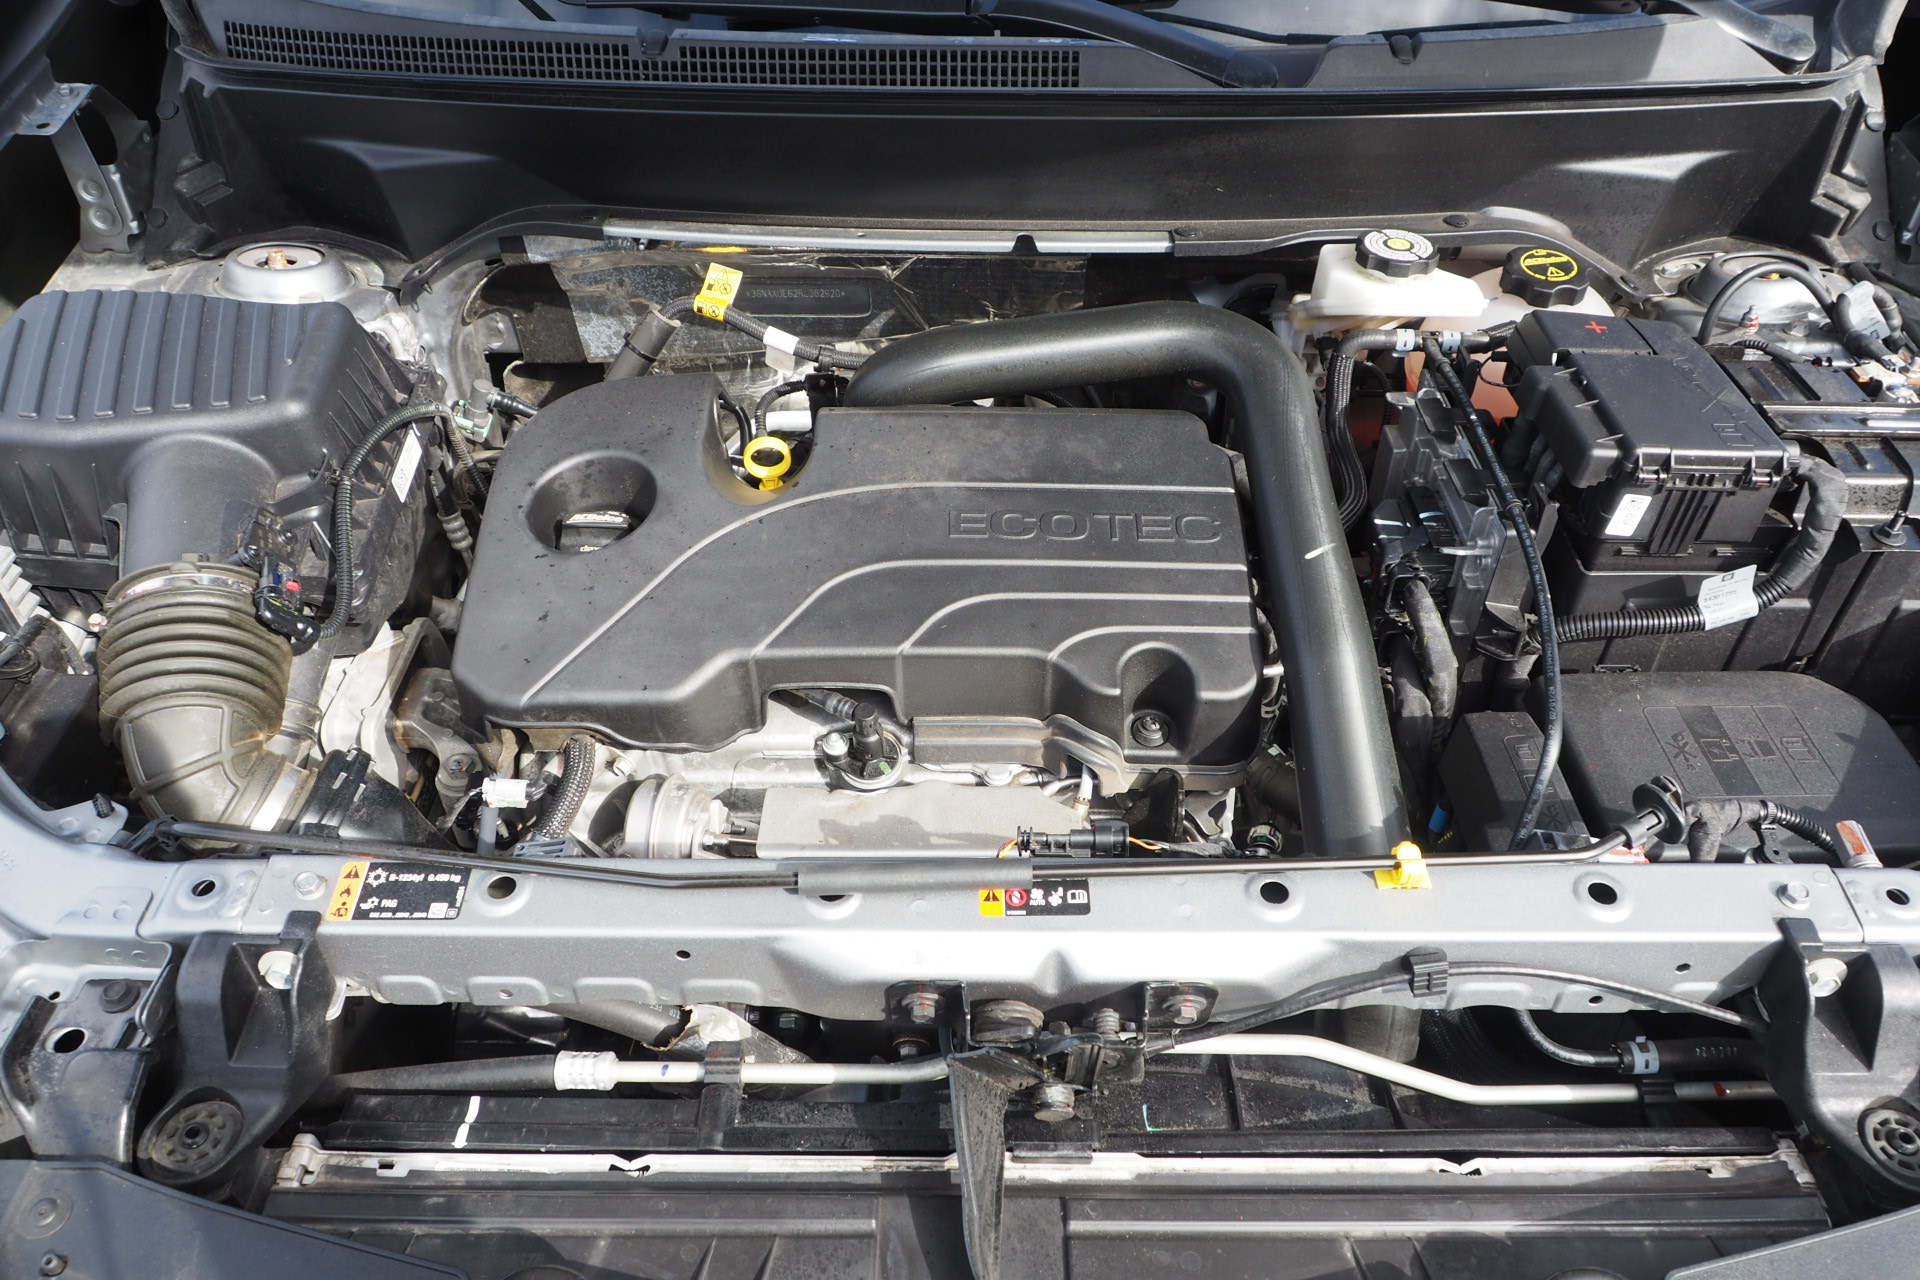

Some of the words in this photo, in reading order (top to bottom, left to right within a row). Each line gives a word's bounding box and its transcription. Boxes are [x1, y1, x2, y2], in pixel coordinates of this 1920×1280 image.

[949, 509, 1222, 543] ECOTEC
[1547, 685, 1556, 719] 02/01/24
[380, 899, 398, 908] PAG
